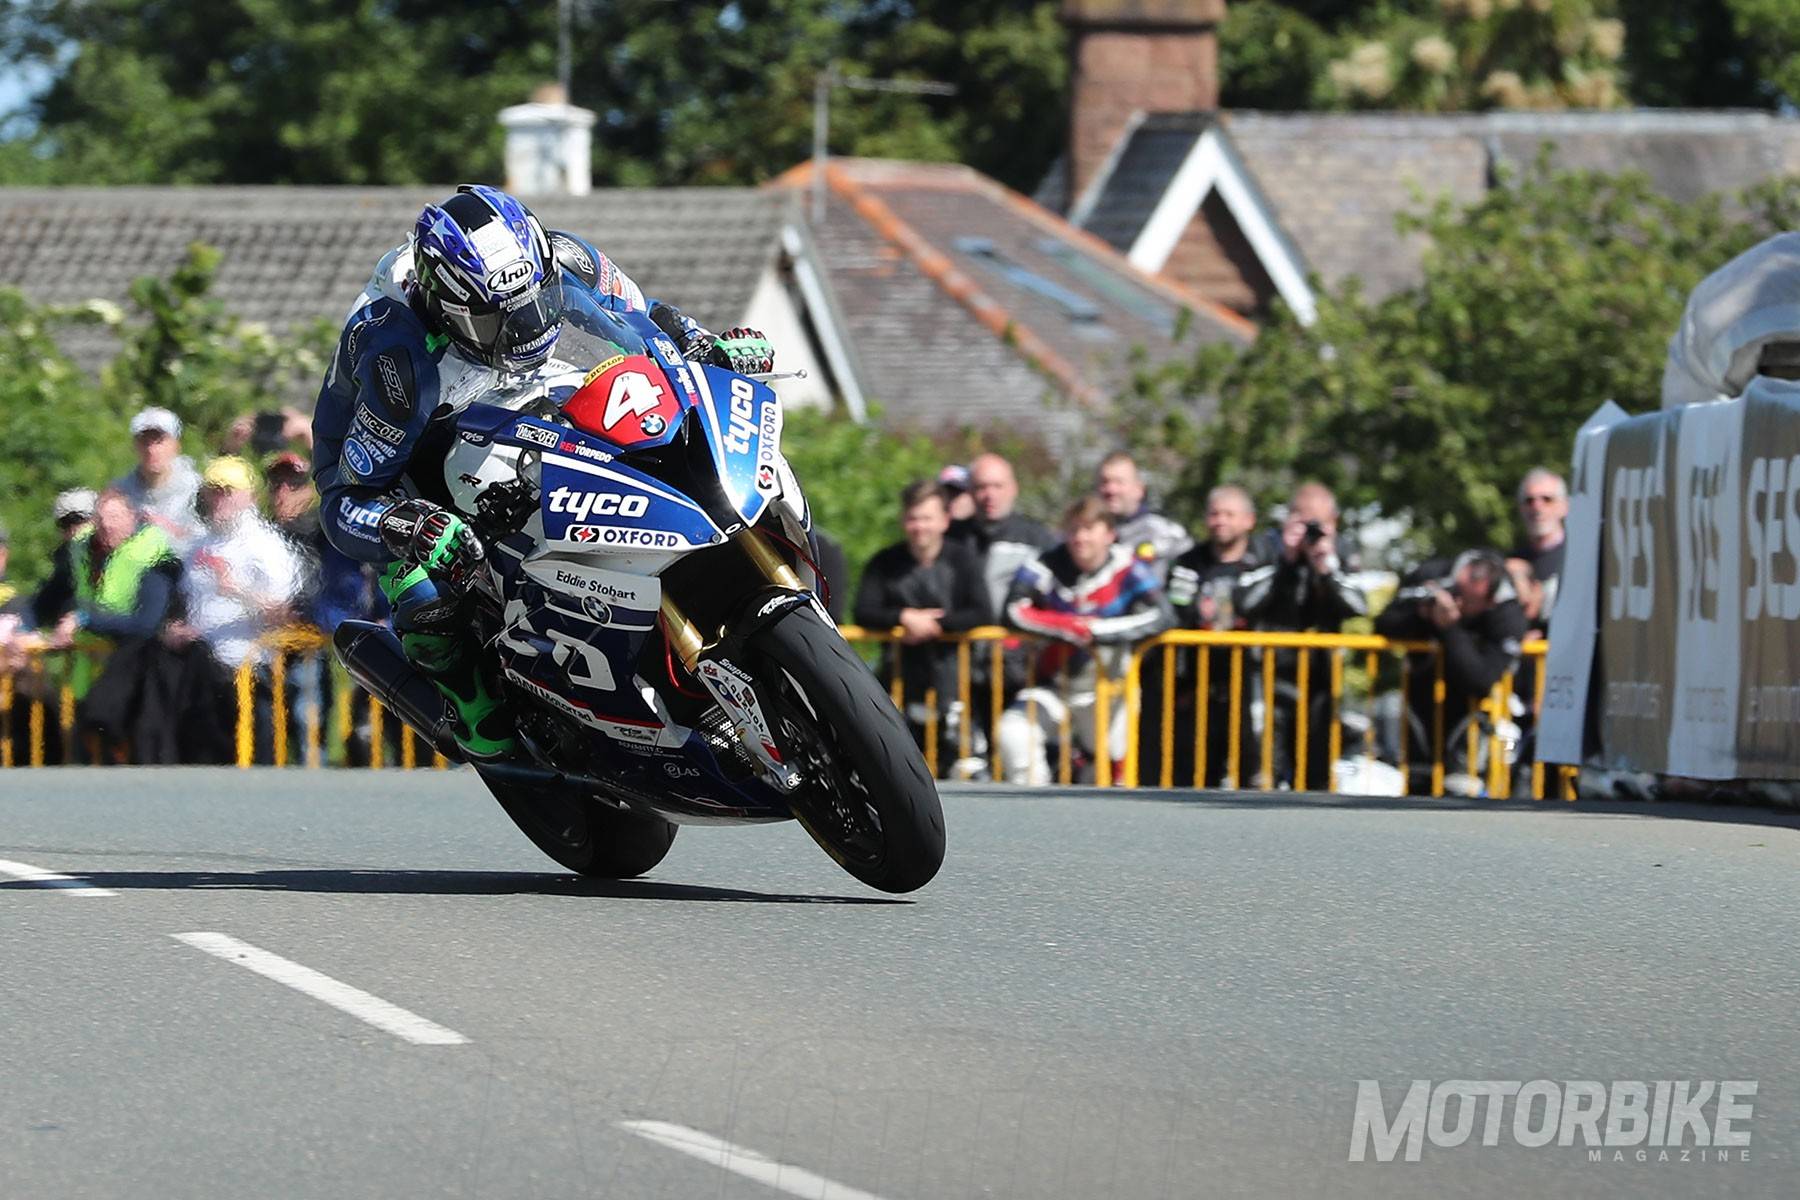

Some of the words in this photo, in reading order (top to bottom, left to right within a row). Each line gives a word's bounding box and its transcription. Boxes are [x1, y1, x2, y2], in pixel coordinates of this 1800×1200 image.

[493, 262, 529, 291] Arai
[379, 355, 410, 409] RST
[590, 356, 624, 380] DUNLOP
[603, 371, 664, 432] 4
[723, 378, 759, 455] tyco
[358, 406, 404, 443] Muc-Off
[518, 426, 557, 447] Muc-Off
[761, 406, 776, 461] OXFORD
[340, 496, 382, 528] tyco
[549, 486, 649, 522] tyco
[604, 529, 679, 547] OXFORD
[1610, 466, 1656, 622] SES
[556, 570, 586, 589] Eddie
[588, 580, 636, 601] Stobart
